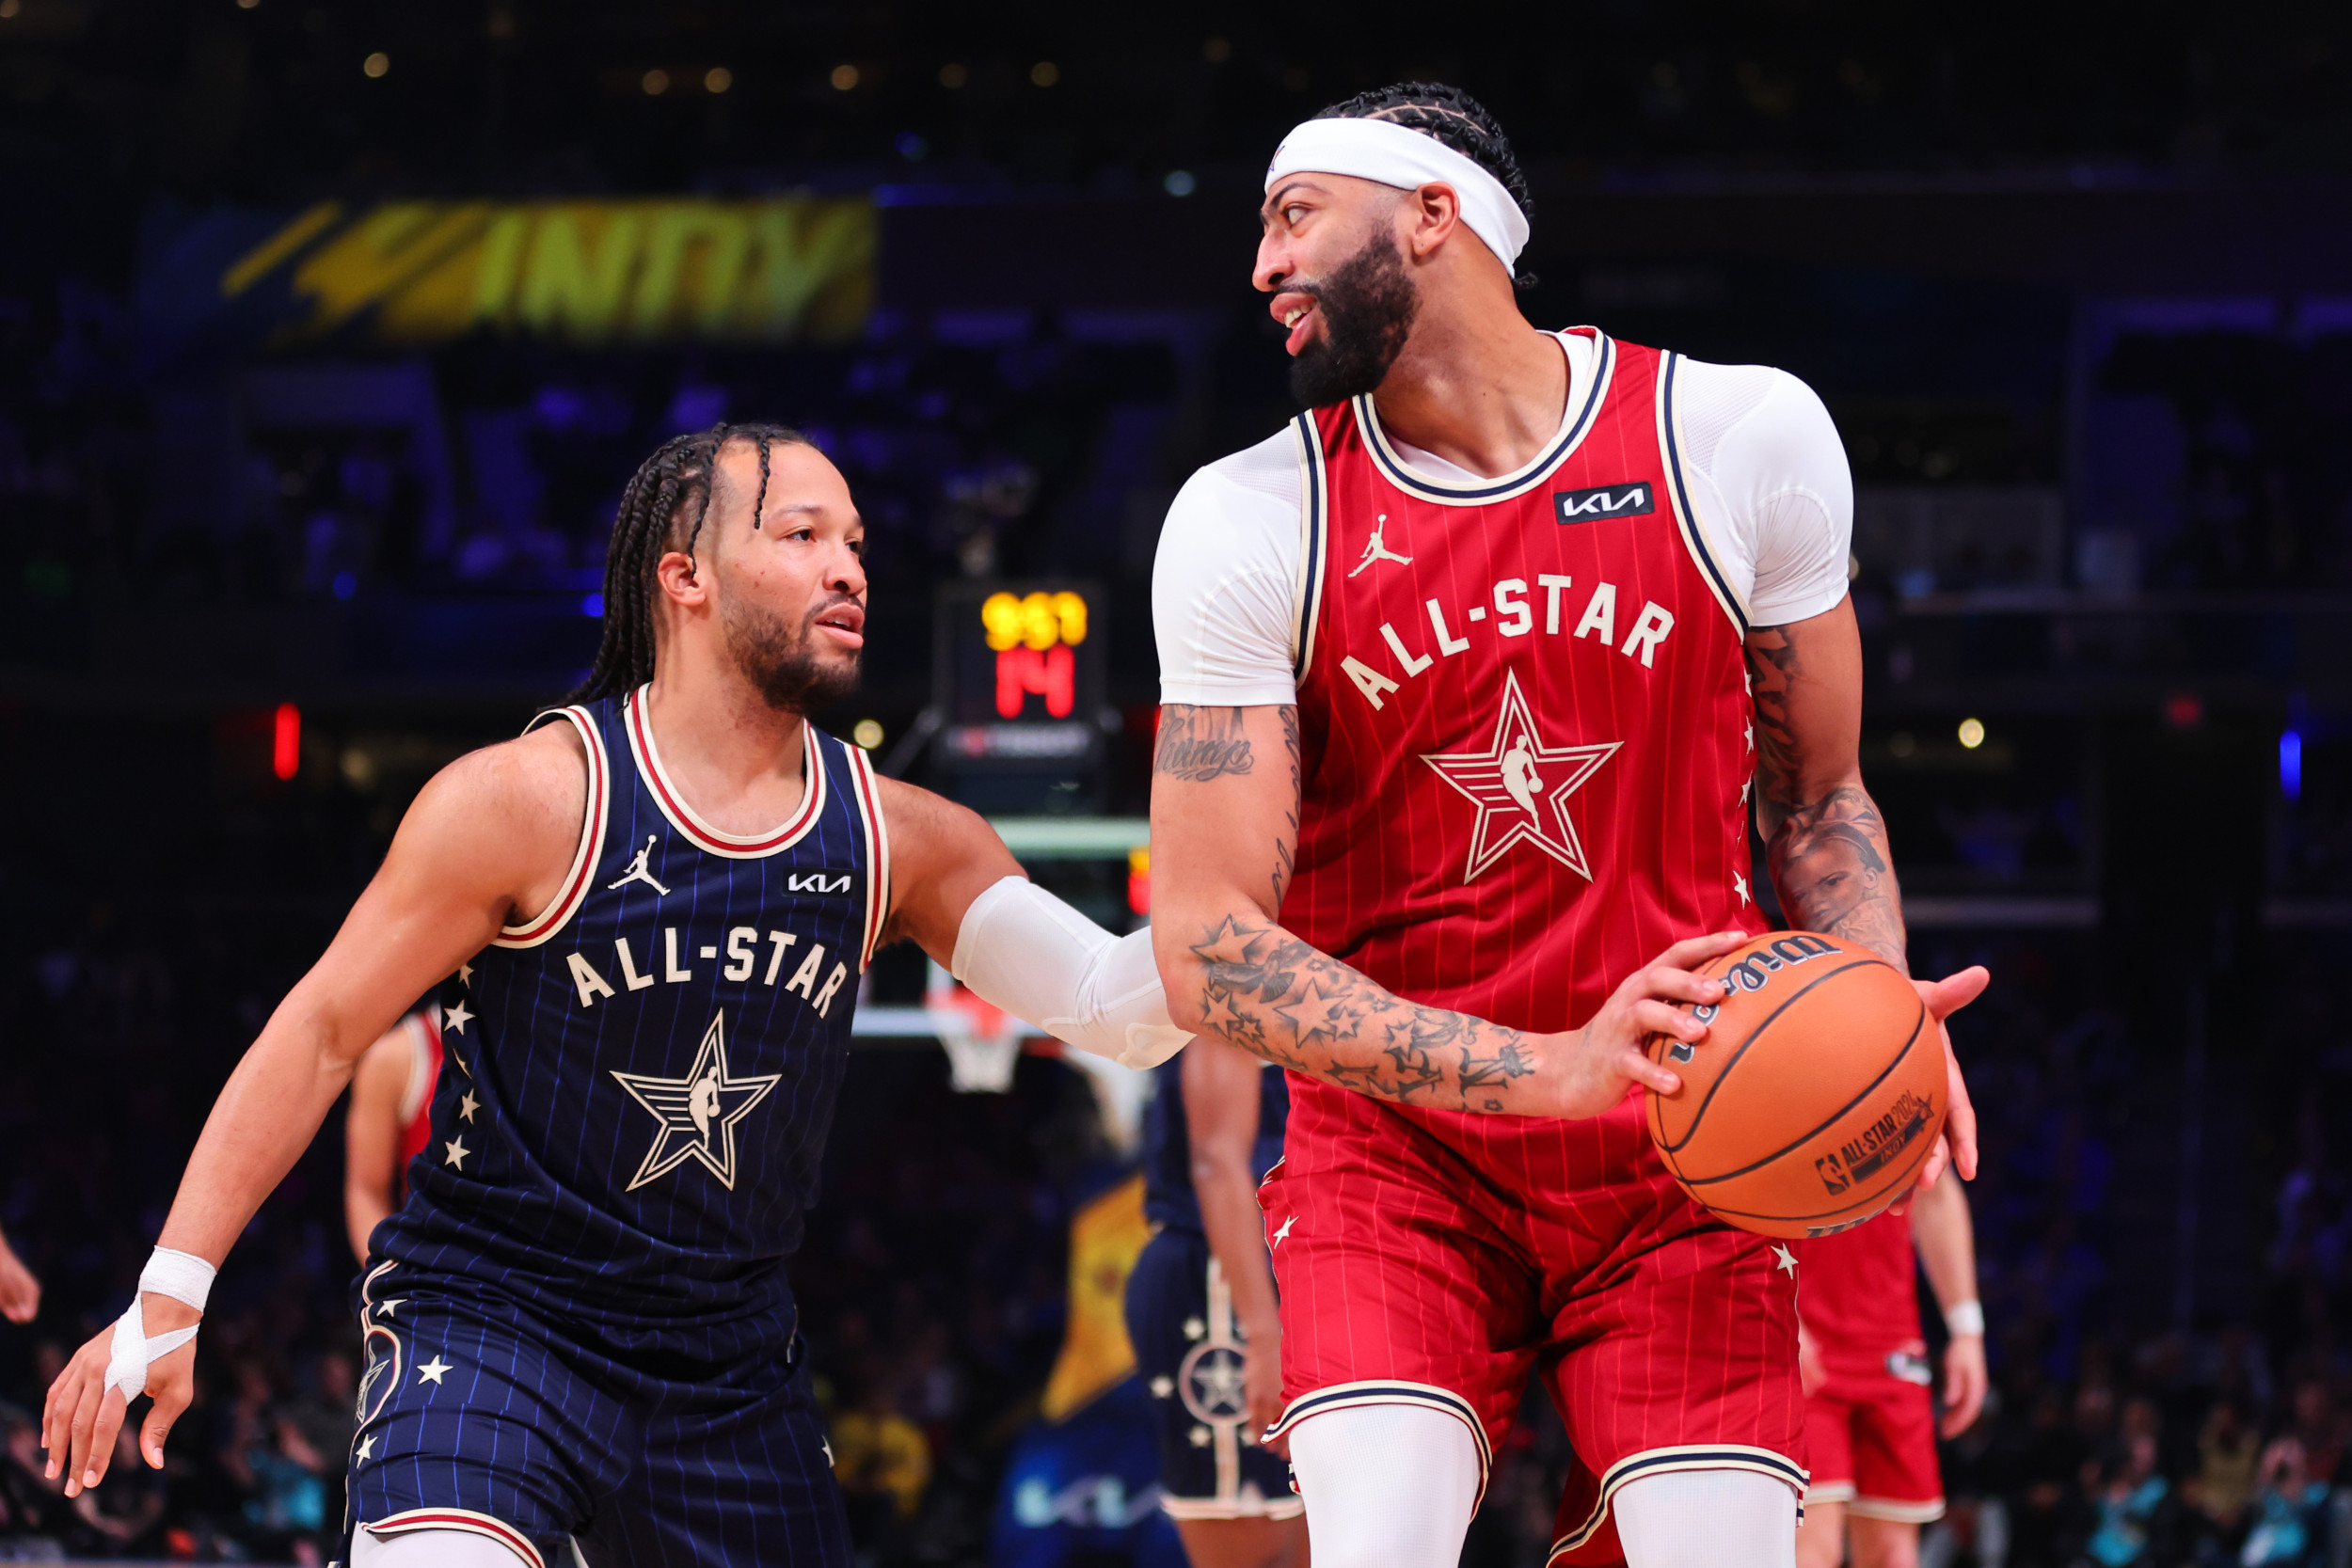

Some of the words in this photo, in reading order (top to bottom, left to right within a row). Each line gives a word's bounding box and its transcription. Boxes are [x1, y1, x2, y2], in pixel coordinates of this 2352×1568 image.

[1564, 488, 1645, 516] KIA
[1341, 574, 1676, 711] ALL-STAR
[788, 873, 851, 894] KIA
[565, 927, 848, 1020] ALL-STAR
[1841, 1114, 1898, 1167] ALL-STAR
